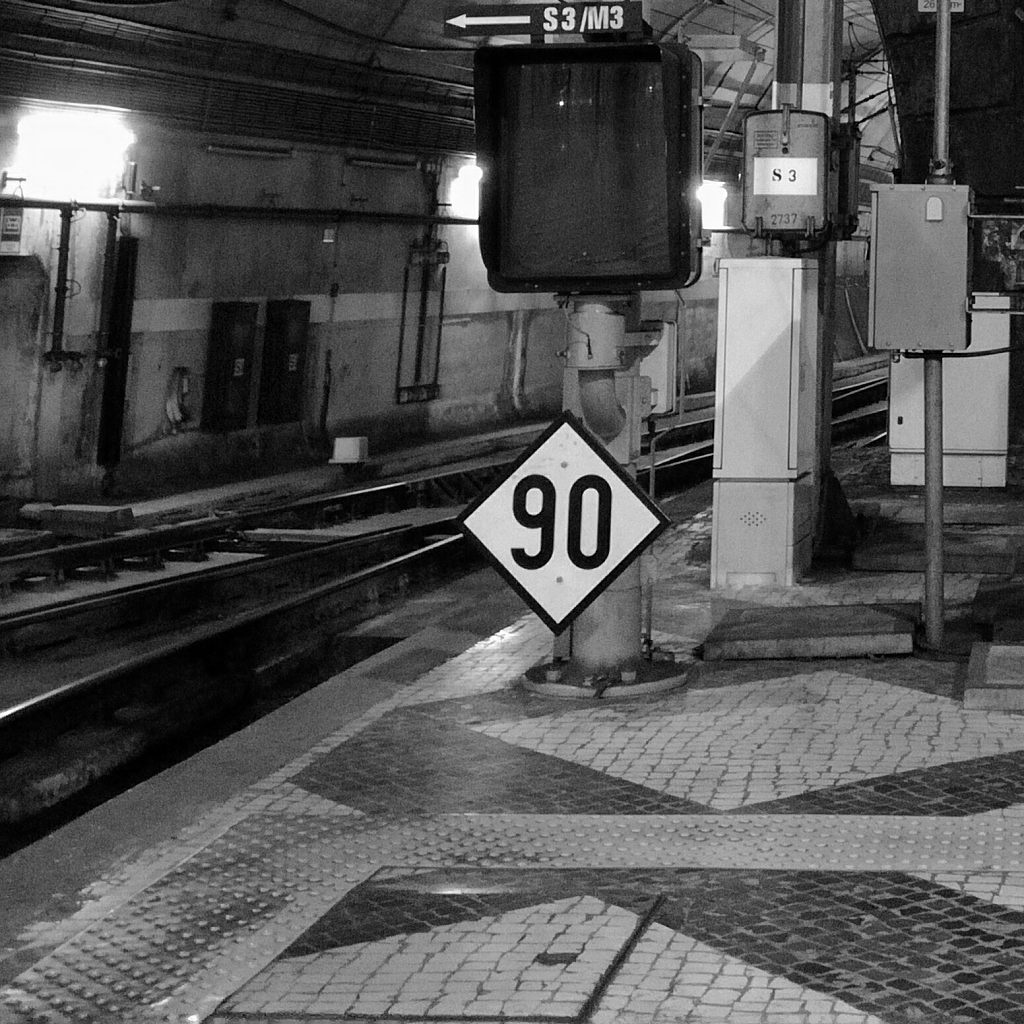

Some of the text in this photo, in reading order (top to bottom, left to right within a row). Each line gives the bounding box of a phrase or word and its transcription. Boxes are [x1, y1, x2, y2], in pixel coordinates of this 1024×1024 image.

[543, 5, 624, 32] S3/M3
[770, 213, 798, 226] 2737
[510, 474, 612, 570] 90
